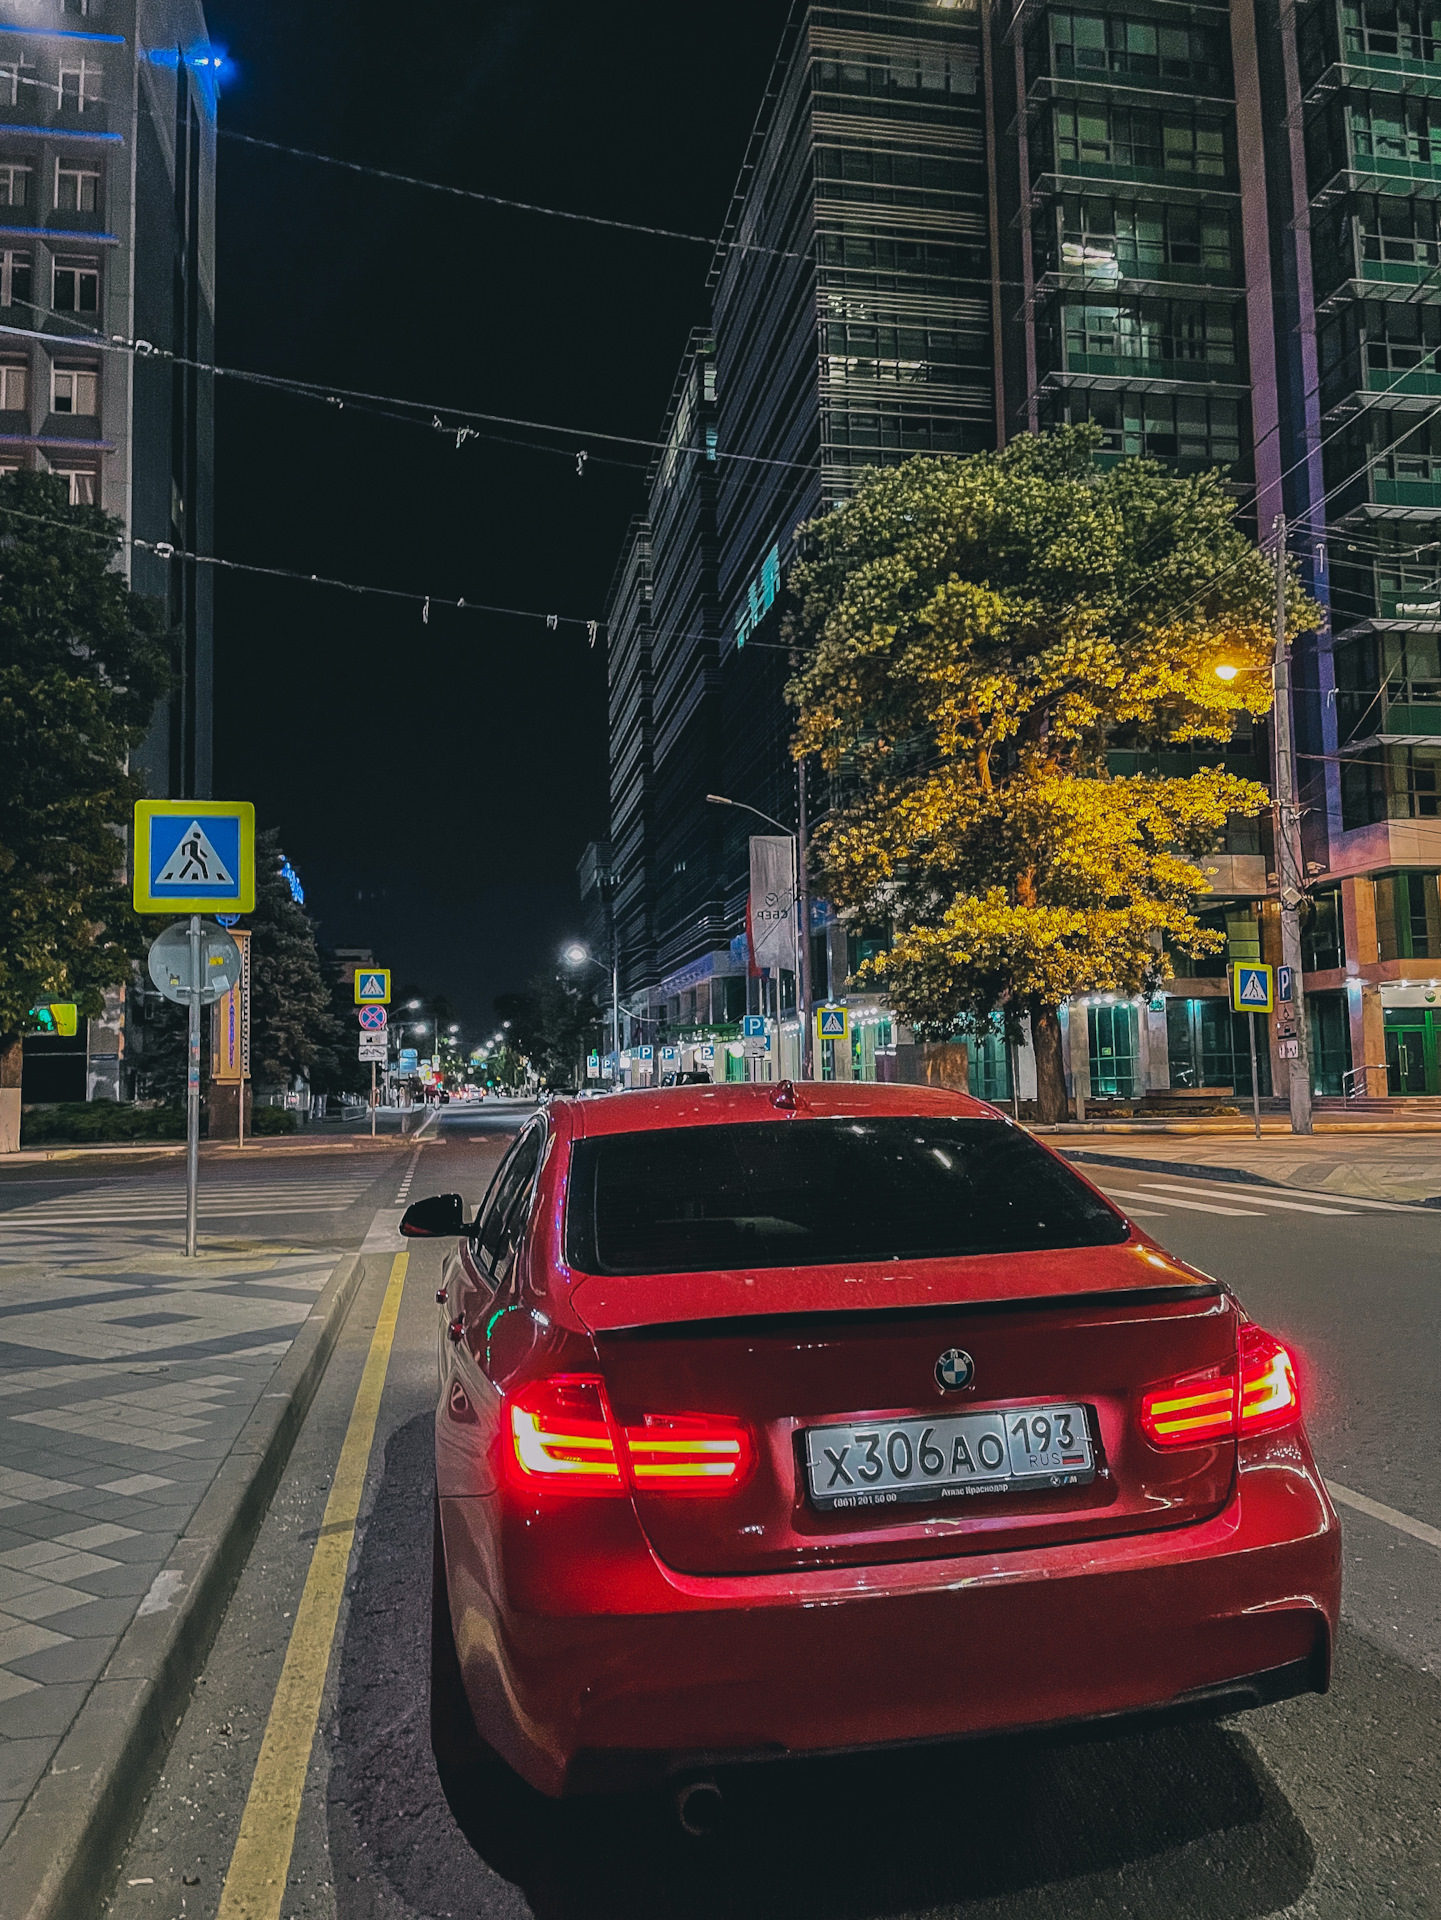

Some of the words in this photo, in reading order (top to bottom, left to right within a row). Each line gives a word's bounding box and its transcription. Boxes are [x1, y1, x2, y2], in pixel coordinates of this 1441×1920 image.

[1281, 970, 1289, 998] P
[749, 1018, 761, 1035] P
[642, 1047, 651, 1059] P
[664, 1048, 673, 1059] P
[1010, 1412, 1076, 1454] 193
[1029, 1453, 1061, 1468] RUS
[965, 1484, 1008, 1496] Краснодар
[858, 1495, 873, 1506] 201
[874, 1494, 885, 1504] 50
[886, 1493, 897, 1503] 00
